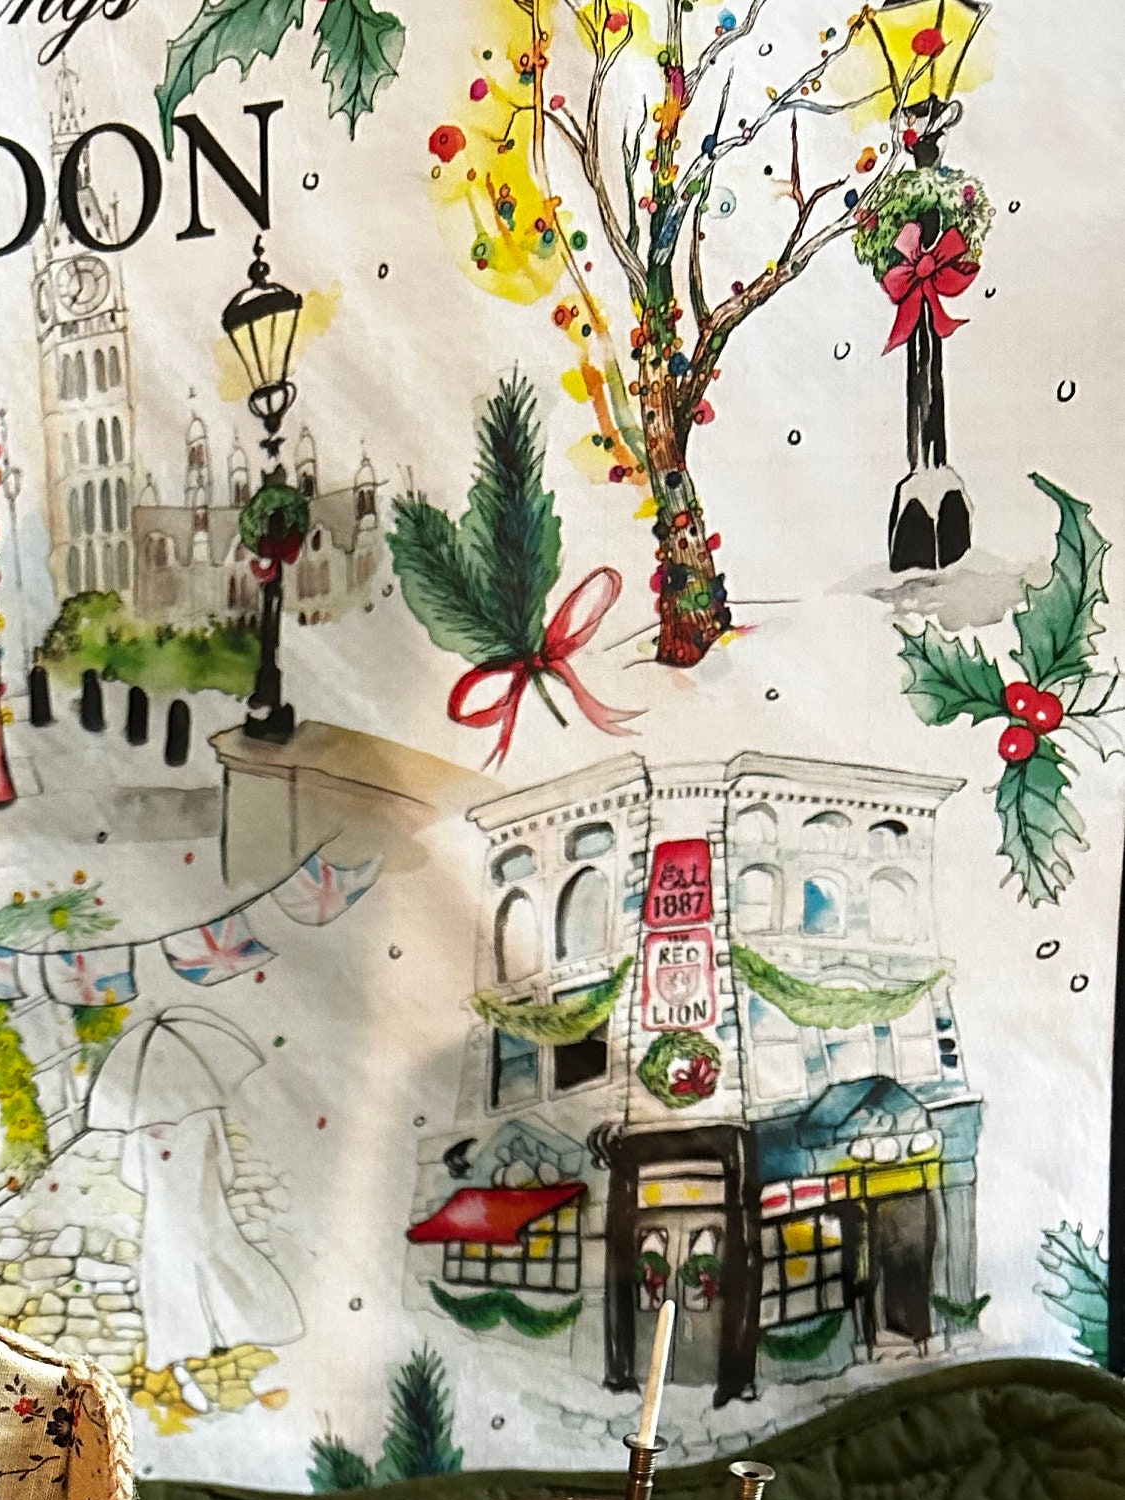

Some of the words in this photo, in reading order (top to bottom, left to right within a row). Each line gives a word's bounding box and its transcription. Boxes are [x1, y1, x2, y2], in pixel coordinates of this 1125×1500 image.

[652, 892, 705, 919] 1887
[658, 946, 700, 965] RED
[652, 1002, 707, 1026] LION
